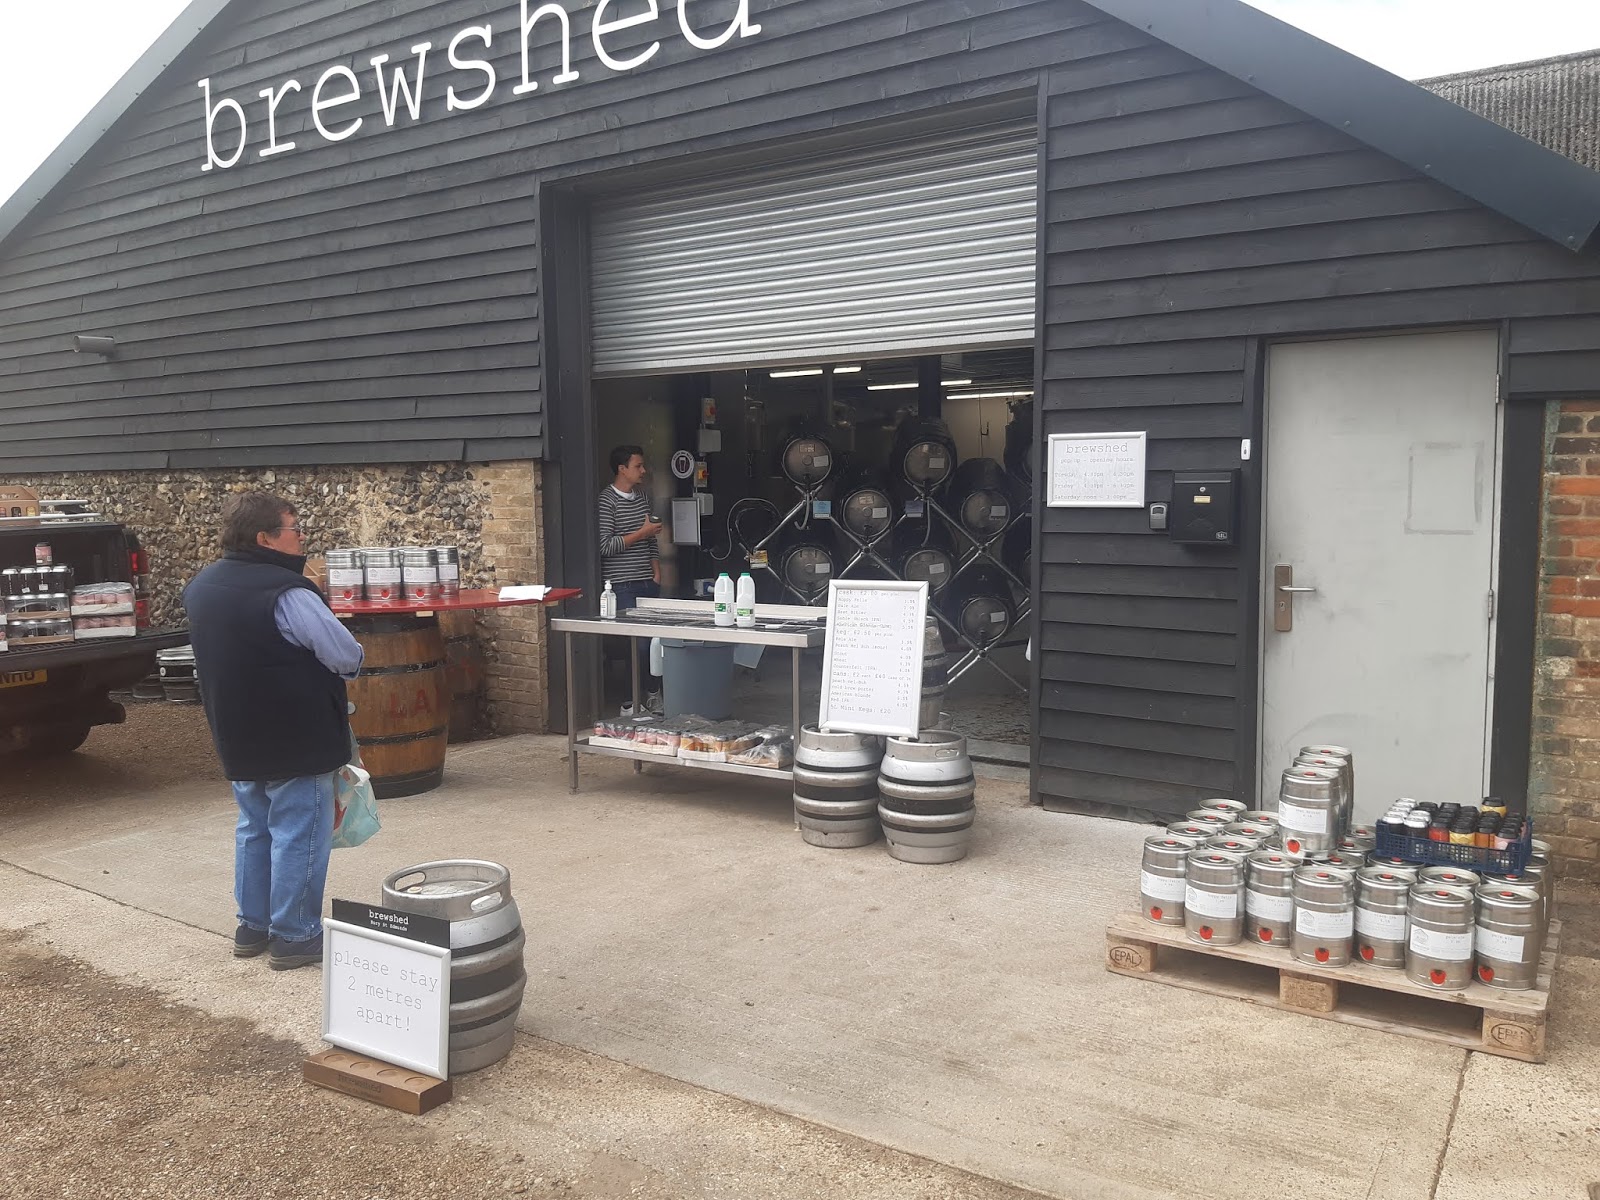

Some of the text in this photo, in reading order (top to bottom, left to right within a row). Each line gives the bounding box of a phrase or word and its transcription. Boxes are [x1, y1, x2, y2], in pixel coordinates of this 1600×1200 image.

[1066, 442, 1128, 454] brewshed
[369, 908, 409, 925] brewshed
[1114, 949, 1137, 965] EPAL
[334, 950, 438, 992] please stay
[348, 975, 422, 1010] 2 metres
[357, 1006, 410, 1032] apart!
